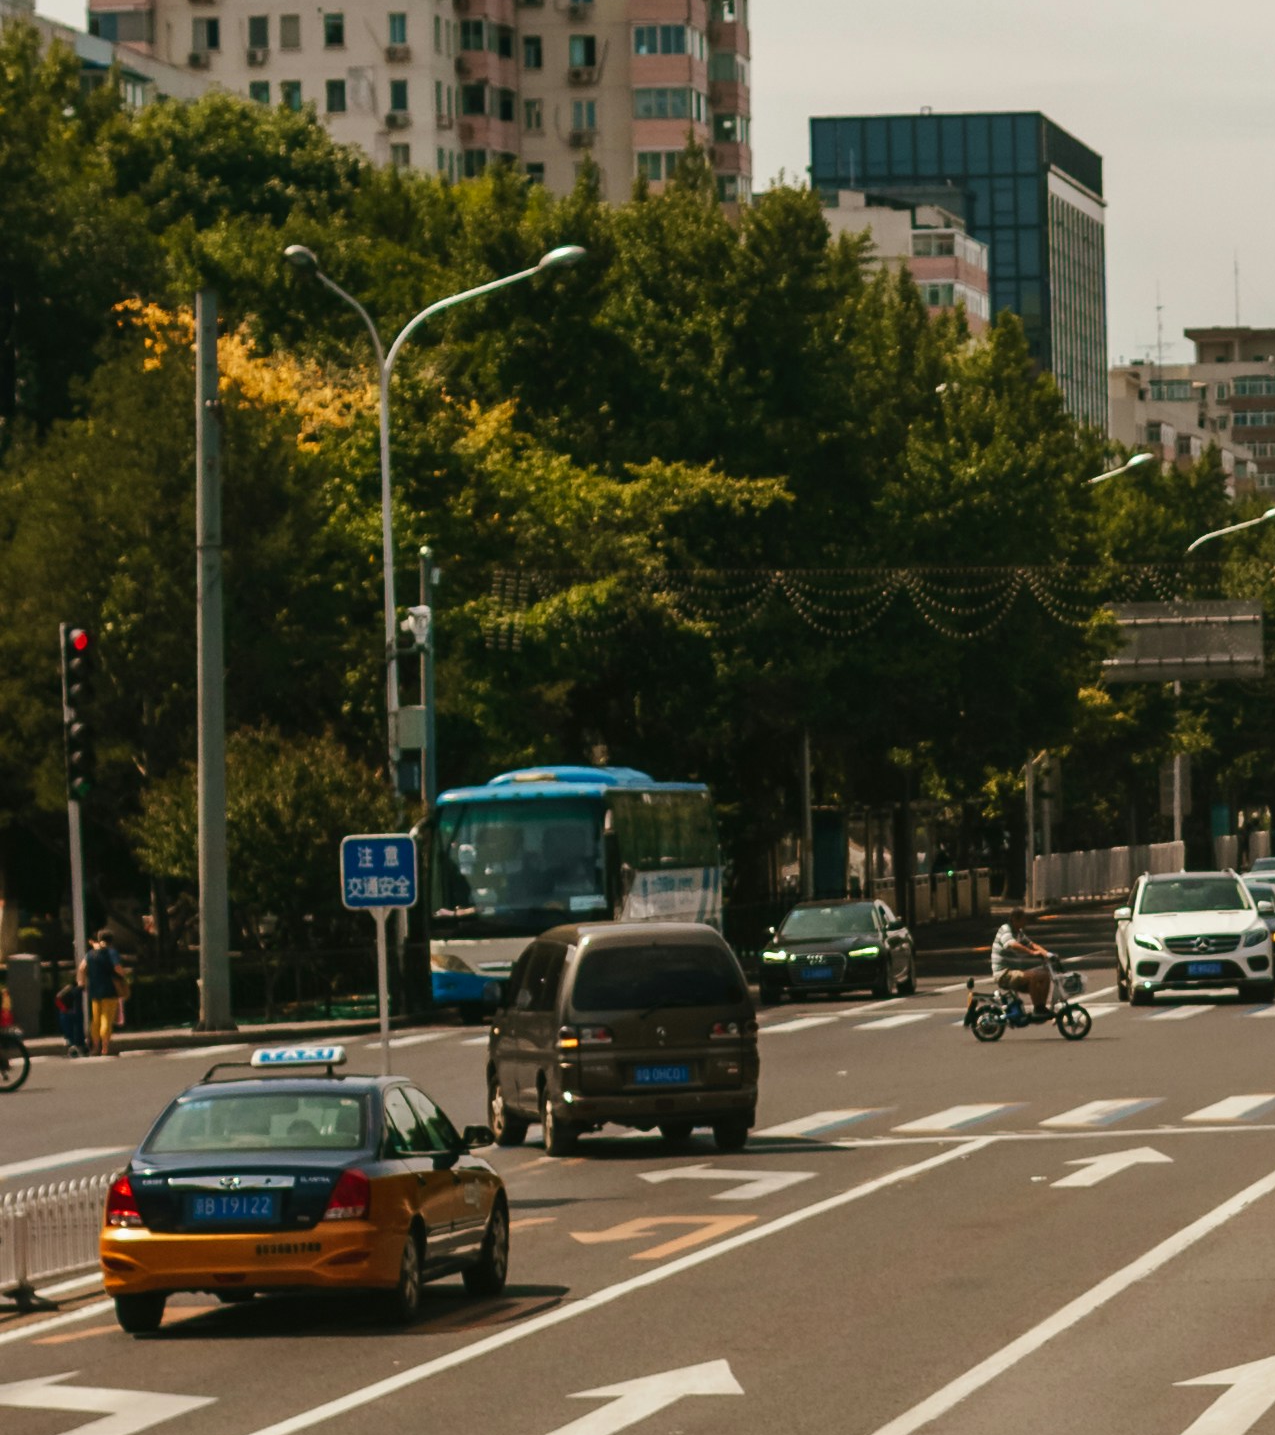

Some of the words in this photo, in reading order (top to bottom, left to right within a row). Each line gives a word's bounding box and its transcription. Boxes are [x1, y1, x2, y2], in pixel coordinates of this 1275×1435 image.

[358, 846, 399, 867] 注意
[347, 875, 410, 899] 交通安全
